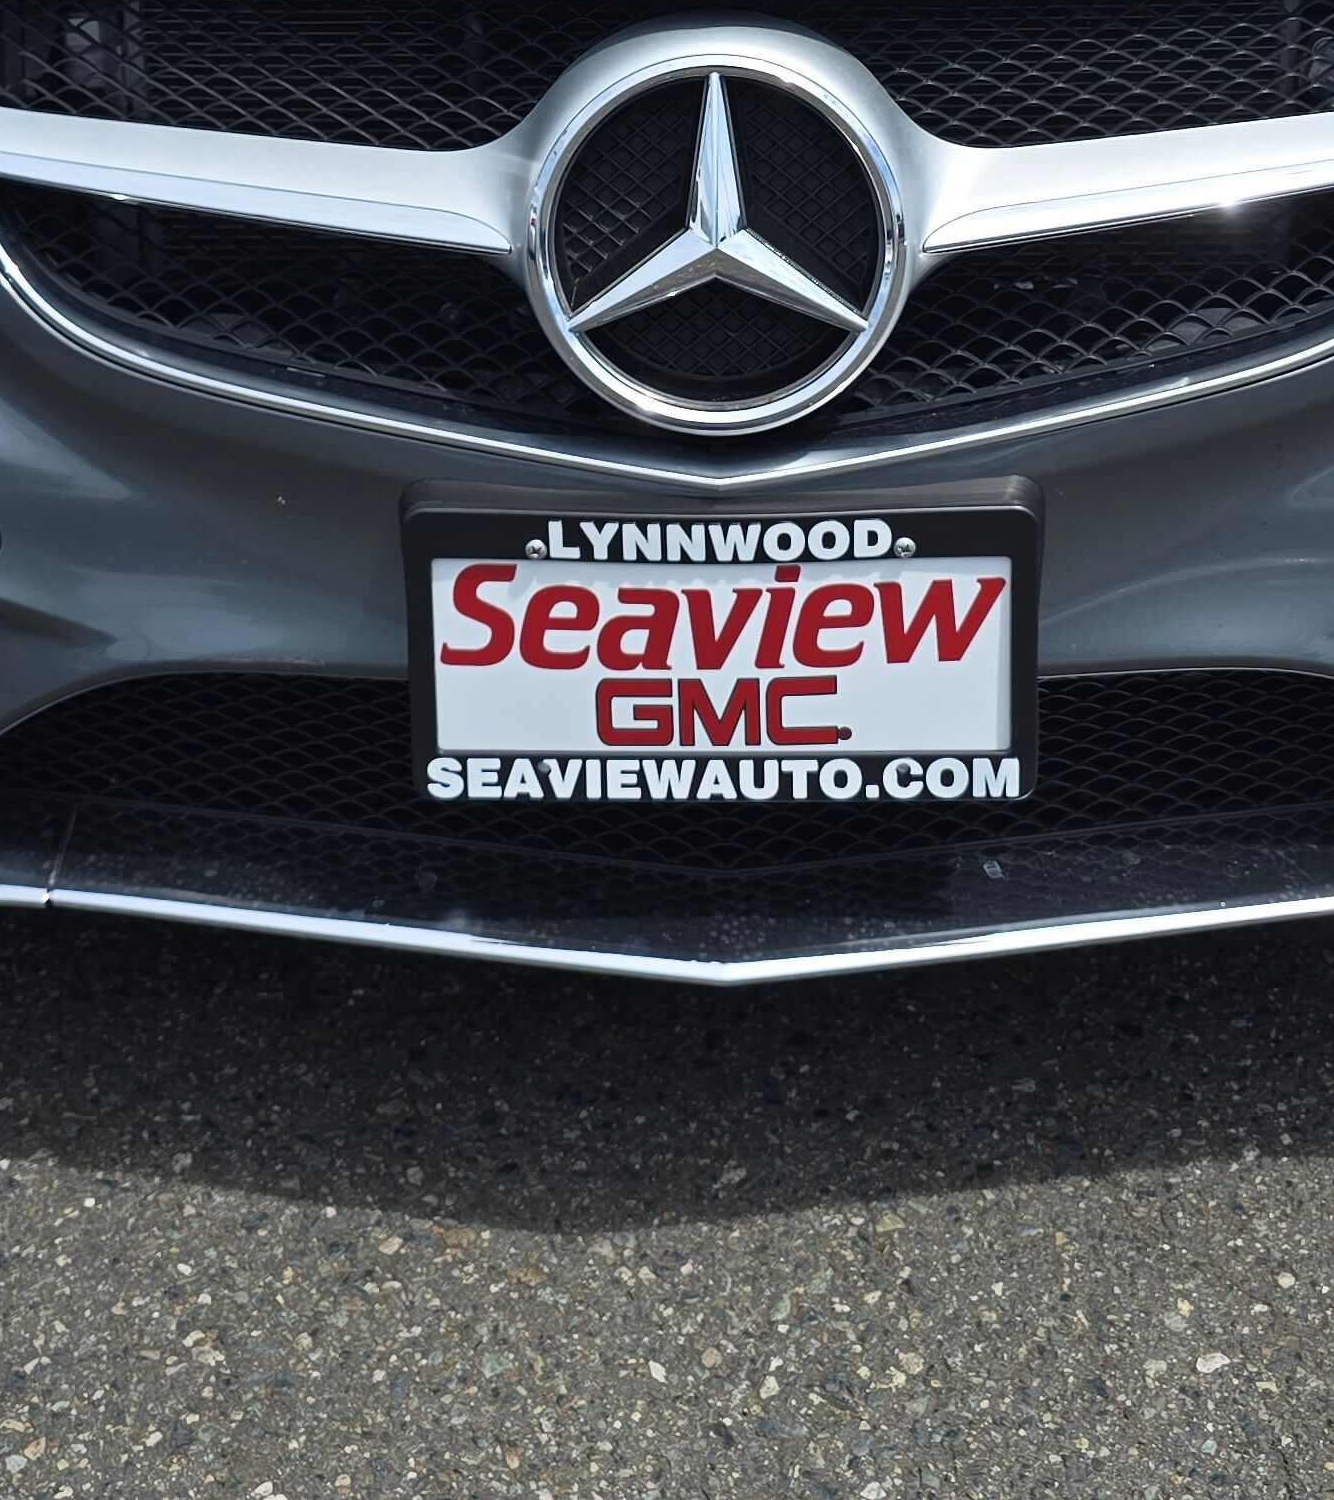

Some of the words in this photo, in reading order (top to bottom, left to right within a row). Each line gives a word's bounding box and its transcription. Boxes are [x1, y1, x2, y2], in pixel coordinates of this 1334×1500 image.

[547, 519, 894, 563] LYNNWOOD
[440, 563, 1007, 672] Seaview
[595, 675, 853, 747] GMC
[426, 757, 1022, 800] SEAVIEWAUTO.COM
